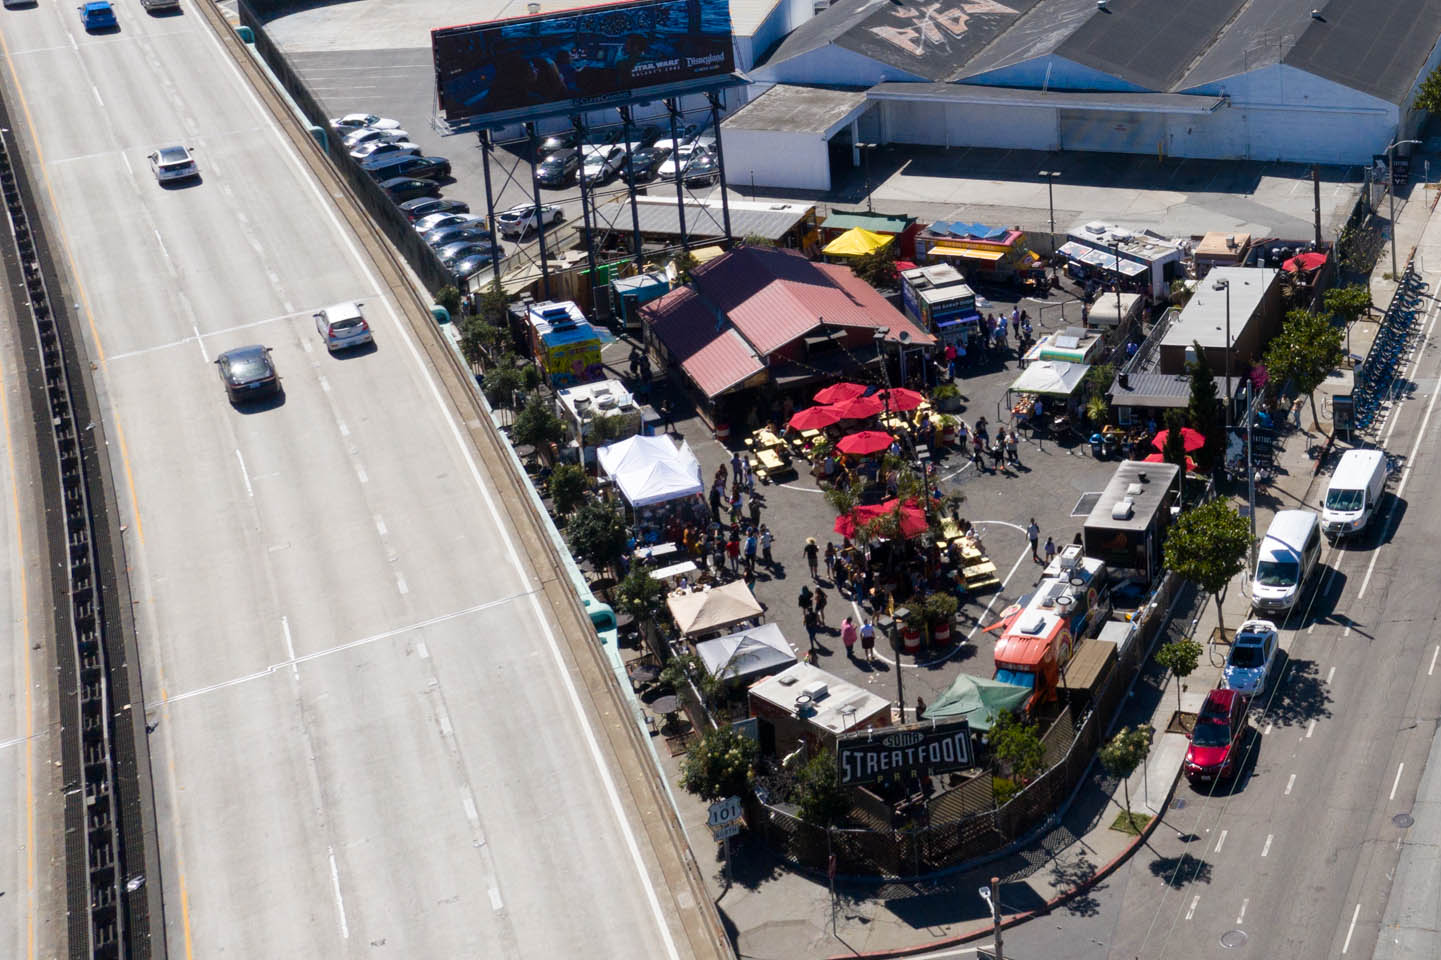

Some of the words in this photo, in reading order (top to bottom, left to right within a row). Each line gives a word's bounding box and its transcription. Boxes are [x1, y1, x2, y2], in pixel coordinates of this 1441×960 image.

[631, 63, 656, 73] STAR
[656, 58, 680, 69] WARS
[687, 51, 725, 67] Disneyland
[887, 731, 920, 747] SOMA
[877, 766, 935, 784] PARK
[713, 805, 736, 823] 101
